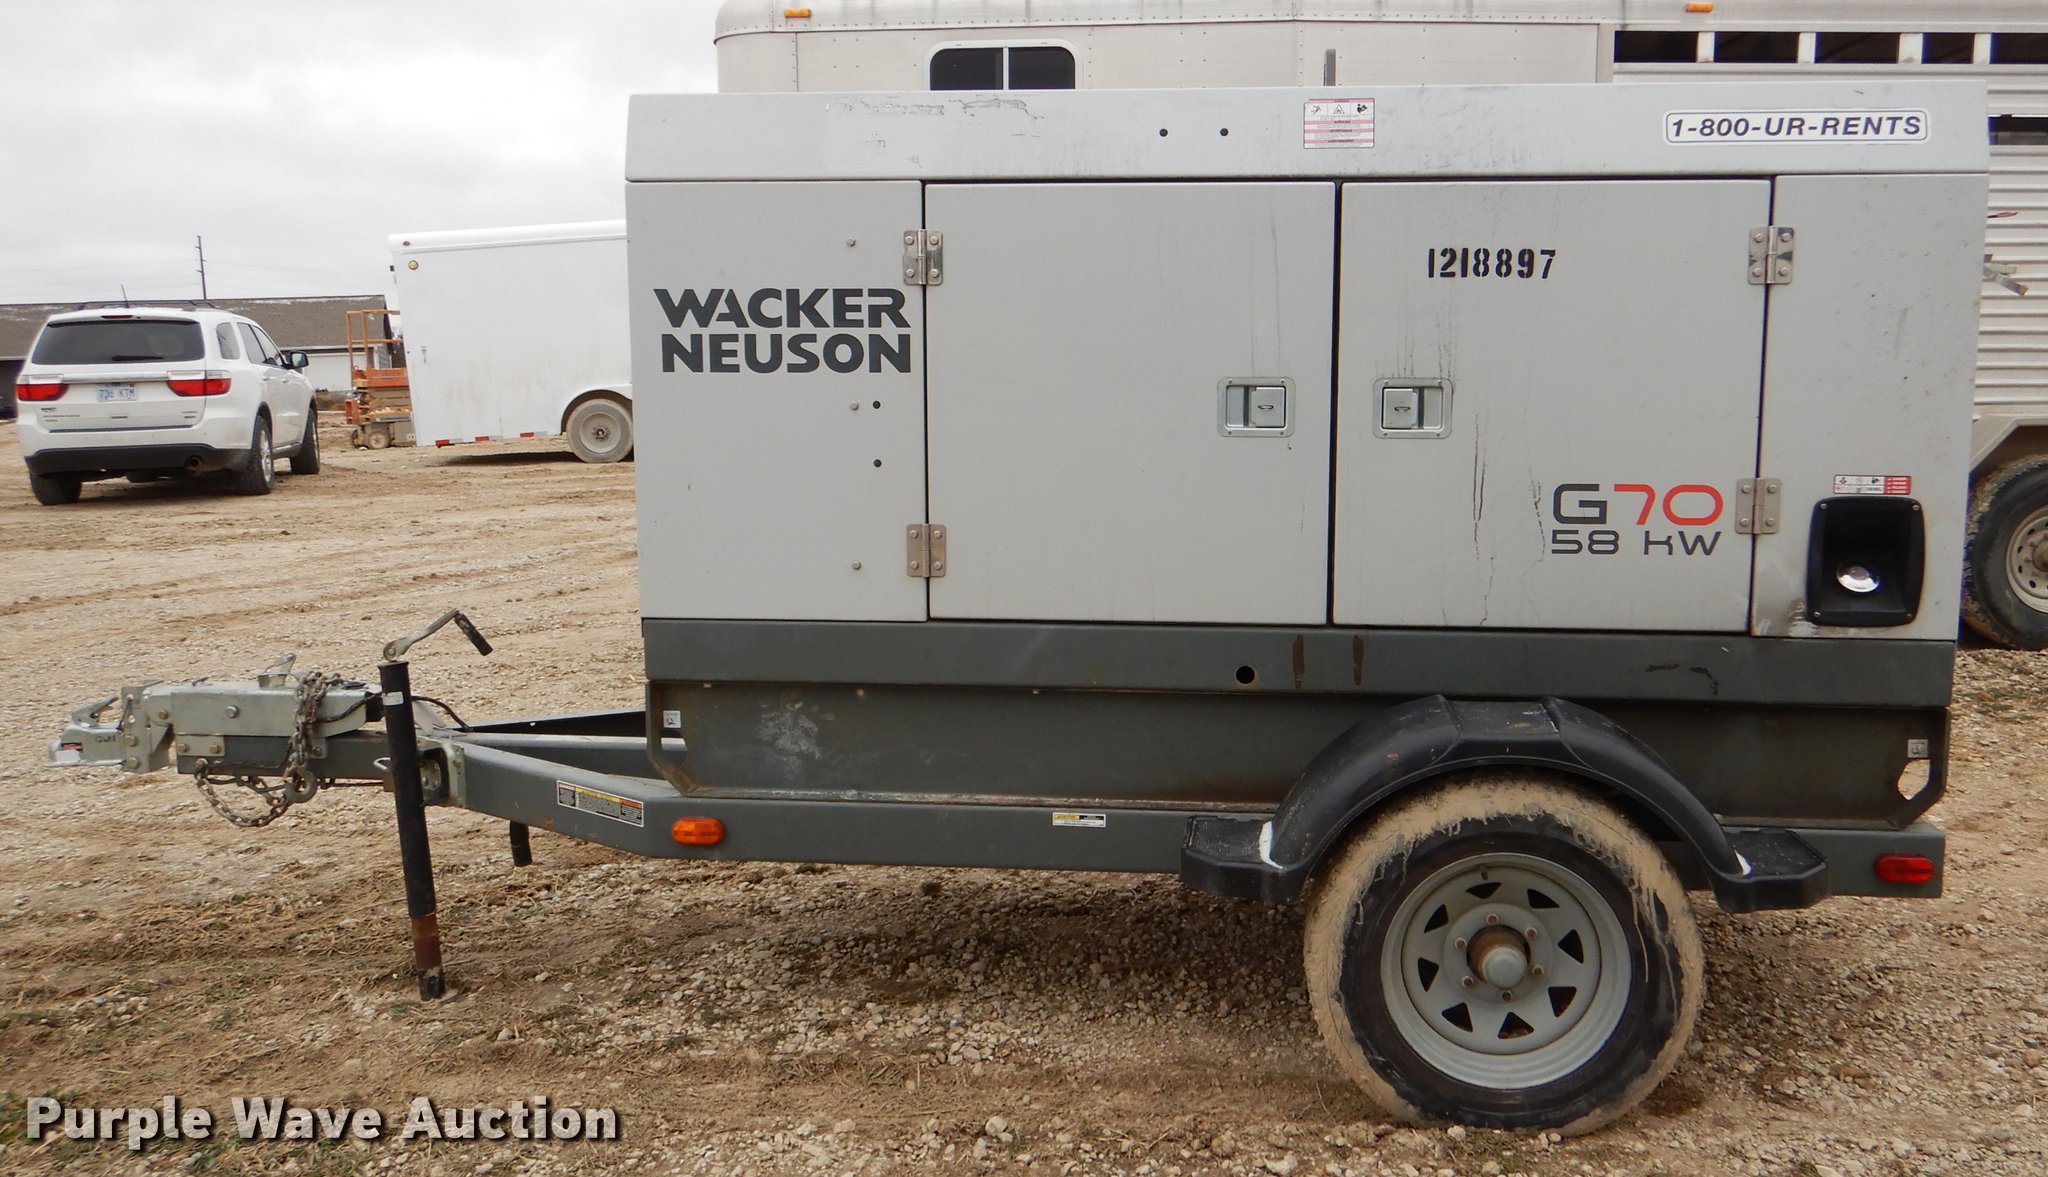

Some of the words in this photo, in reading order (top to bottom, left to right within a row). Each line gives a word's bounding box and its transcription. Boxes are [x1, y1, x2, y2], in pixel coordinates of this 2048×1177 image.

[1671, 116, 1921, 137] 1-800-UR-RENTS
[1428, 247, 1556, 279] 1218897
[653, 288, 911, 328] WACKER
[661, 333, 911, 373] NEUSON
[1553, 483, 1724, 526] G70
[1551, 529, 1620, 555] 58
